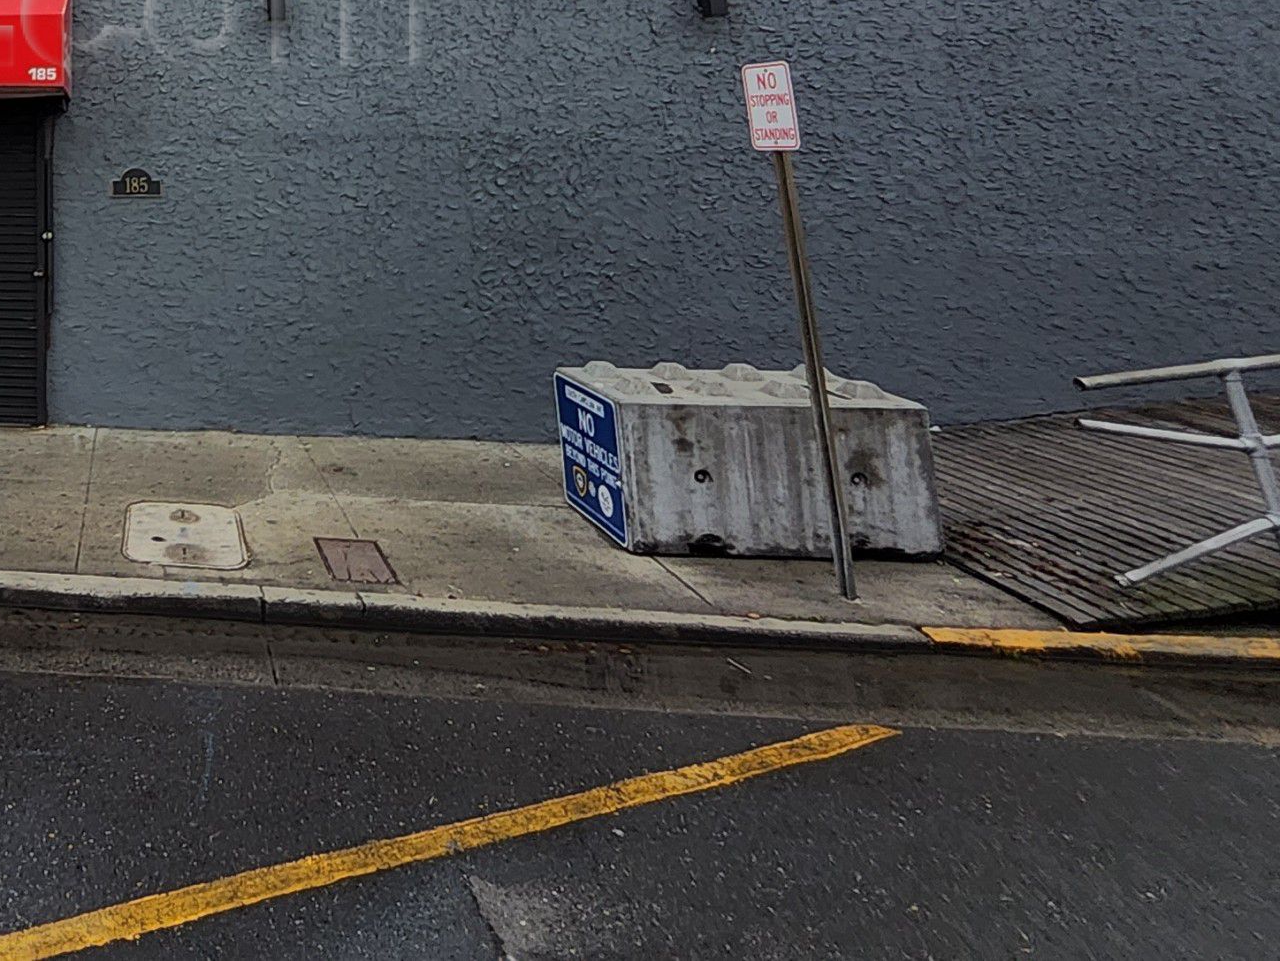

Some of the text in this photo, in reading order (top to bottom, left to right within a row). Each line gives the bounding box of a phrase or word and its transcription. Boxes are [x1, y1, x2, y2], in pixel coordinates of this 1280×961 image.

[28, 67, 57, 80] 185
[756, 72, 777, 90] NO
[749, 93, 790, 107] STOPPING
[765, 111, 778, 124] OR
[753, 127, 795, 141] STANDING
[124, 177, 149, 194] 185
[577, 408, 595, 437] NO
[584, 437, 620, 474] VEHICLES
